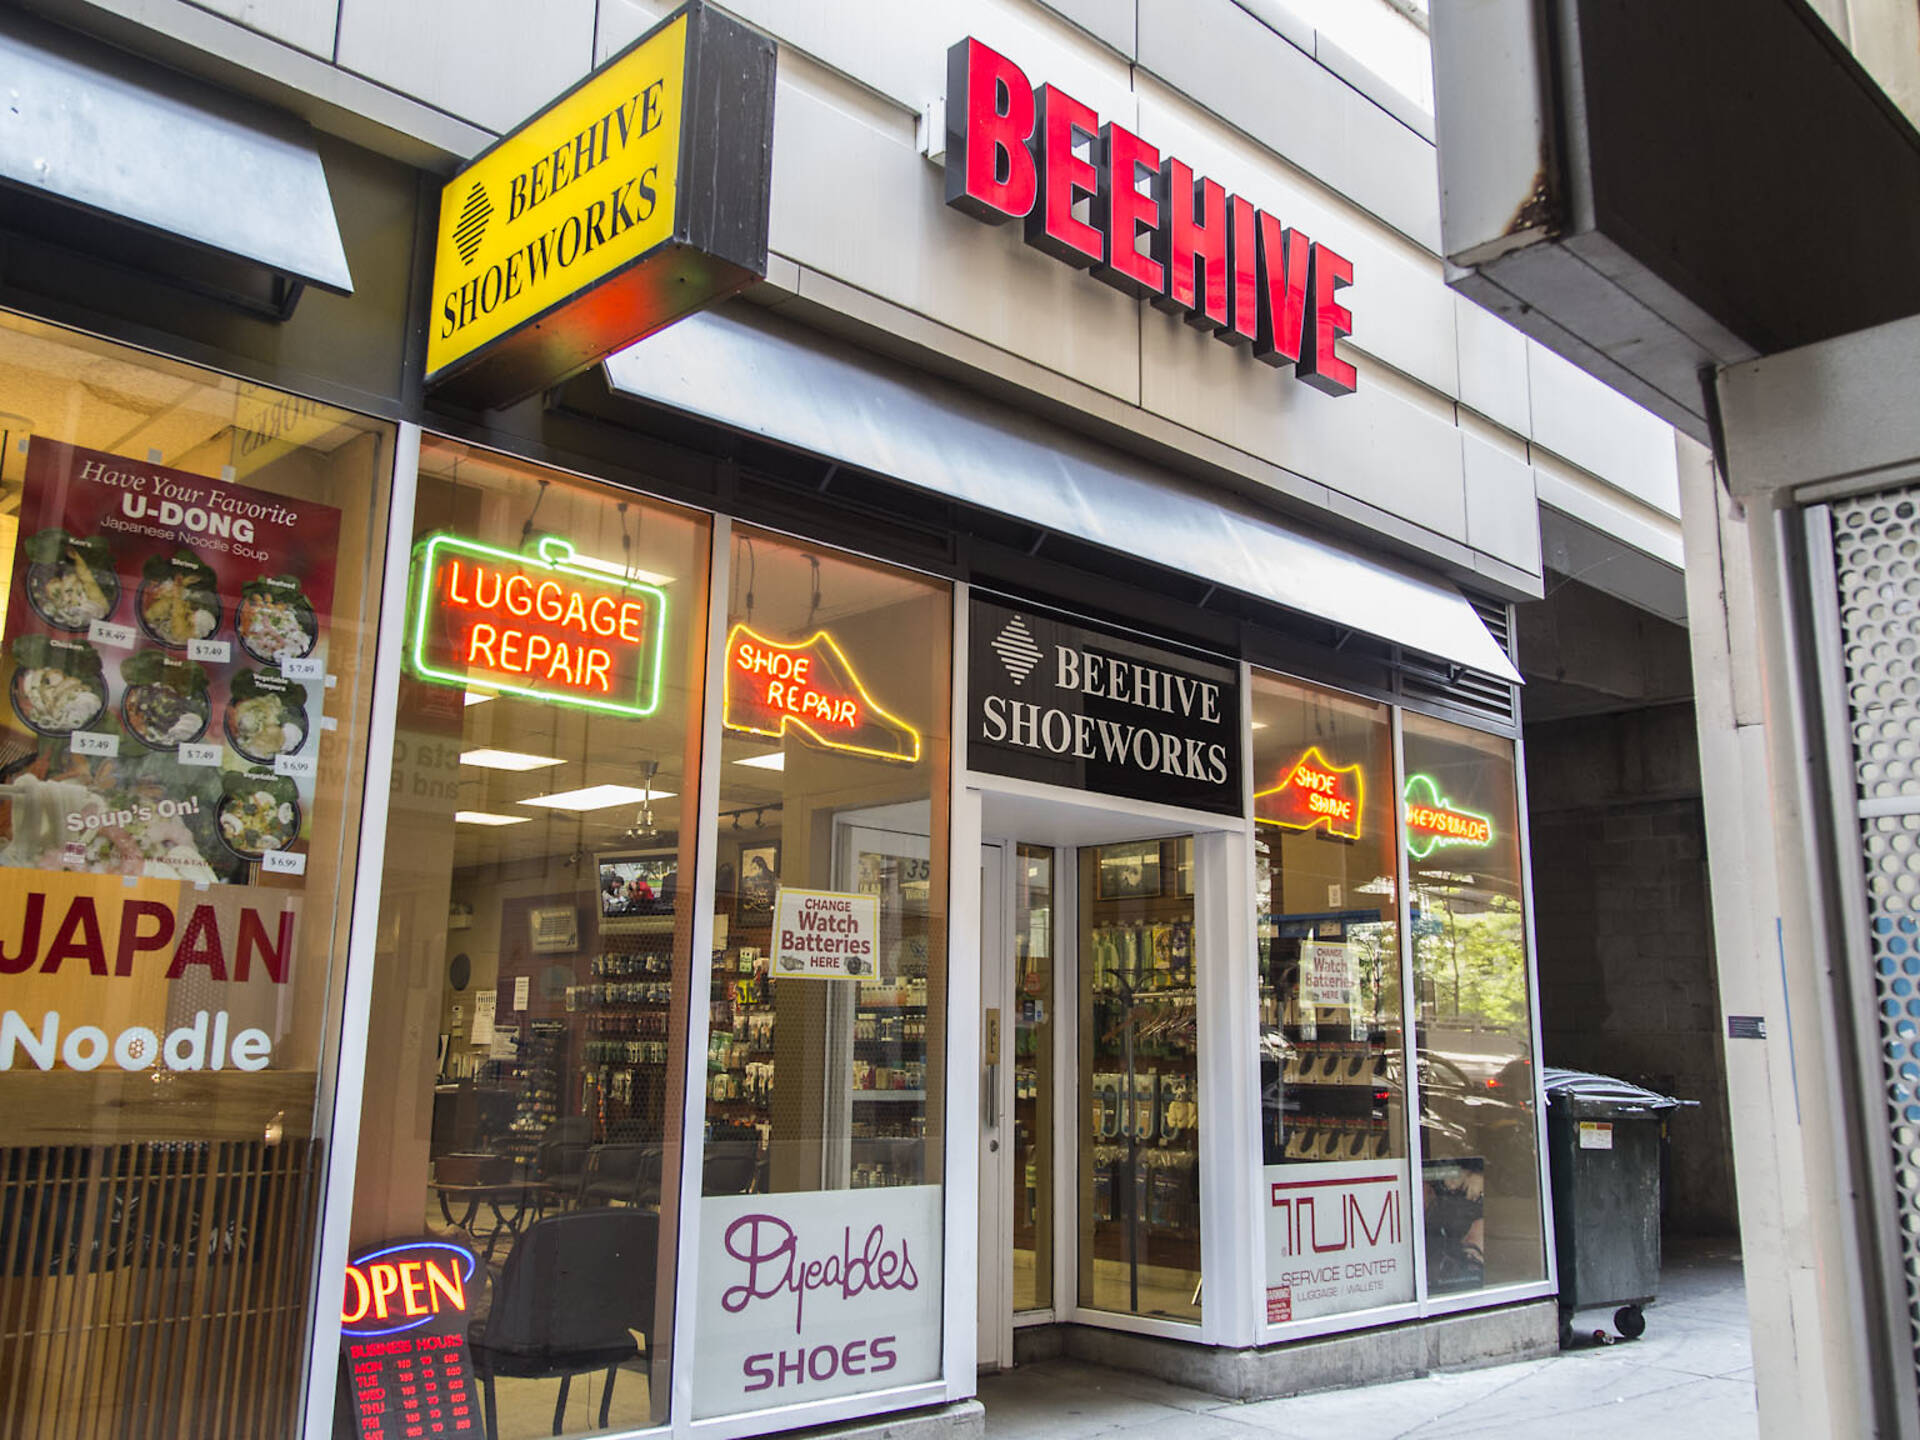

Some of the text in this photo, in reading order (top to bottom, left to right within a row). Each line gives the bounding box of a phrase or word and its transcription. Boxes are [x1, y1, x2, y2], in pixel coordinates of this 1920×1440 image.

[506, 79, 664, 225] BEEHIVE
[946, 36, 1357, 397] BEEHIVE
[440, 164, 659, 341] SHOEWORKS
[80, 460, 298, 527] Have Your Favorite
[100, 515, 269, 562] Japanese Noodle Soup
[122, 492, 255, 544] U-DONG
[450, 559, 642, 643] LUGGAGE
[50, 639, 84, 650] Chicken
[468, 623, 611, 692] REPAIR
[737, 644, 809, 685] SHOE
[767, 681, 857, 727] REPAIR
[1055, 645, 1221, 724] BEEHIVE
[983, 695, 1228, 785] SHOEWORKS
[1295, 766, 1336, 795] SHOE
[66, 795, 200, 832] Soup's On!
[798, 910, 859, 934] Watch
[805, 898, 851, 912] CHANGE
[0, 892, 295, 984] JAPAN
[781, 930, 871, 955] Batteries
[1317, 947, 1343, 957] CHANGE
[810, 956, 840, 969] HERE
[1314, 957, 1348, 973] Watch
[1321, 990, 1339, 1000] HERE
[0, 1010, 272, 1072] Noodle
[1272, 1175, 1402, 1257] TUMI
[341, 1258, 467, 1323] OPEN
[721, 1214, 919, 1334] Dyeables
[1281, 1258, 1397, 1287] SERVICE CENTER
[1296, 1286, 1338, 1302] LUGGAGE
[1347, 1280, 1384, 1295] WALLETS
[350, 1334, 463, 1358] BUSINESS HOURS
[743, 1336, 897, 1392] SHOES
[354, 1361, 383, 1374] MON
[355, 1375, 378, 1388] TUE
[358, 1388, 386, 1402] WED
[360, 1401, 385, 1415] THU
